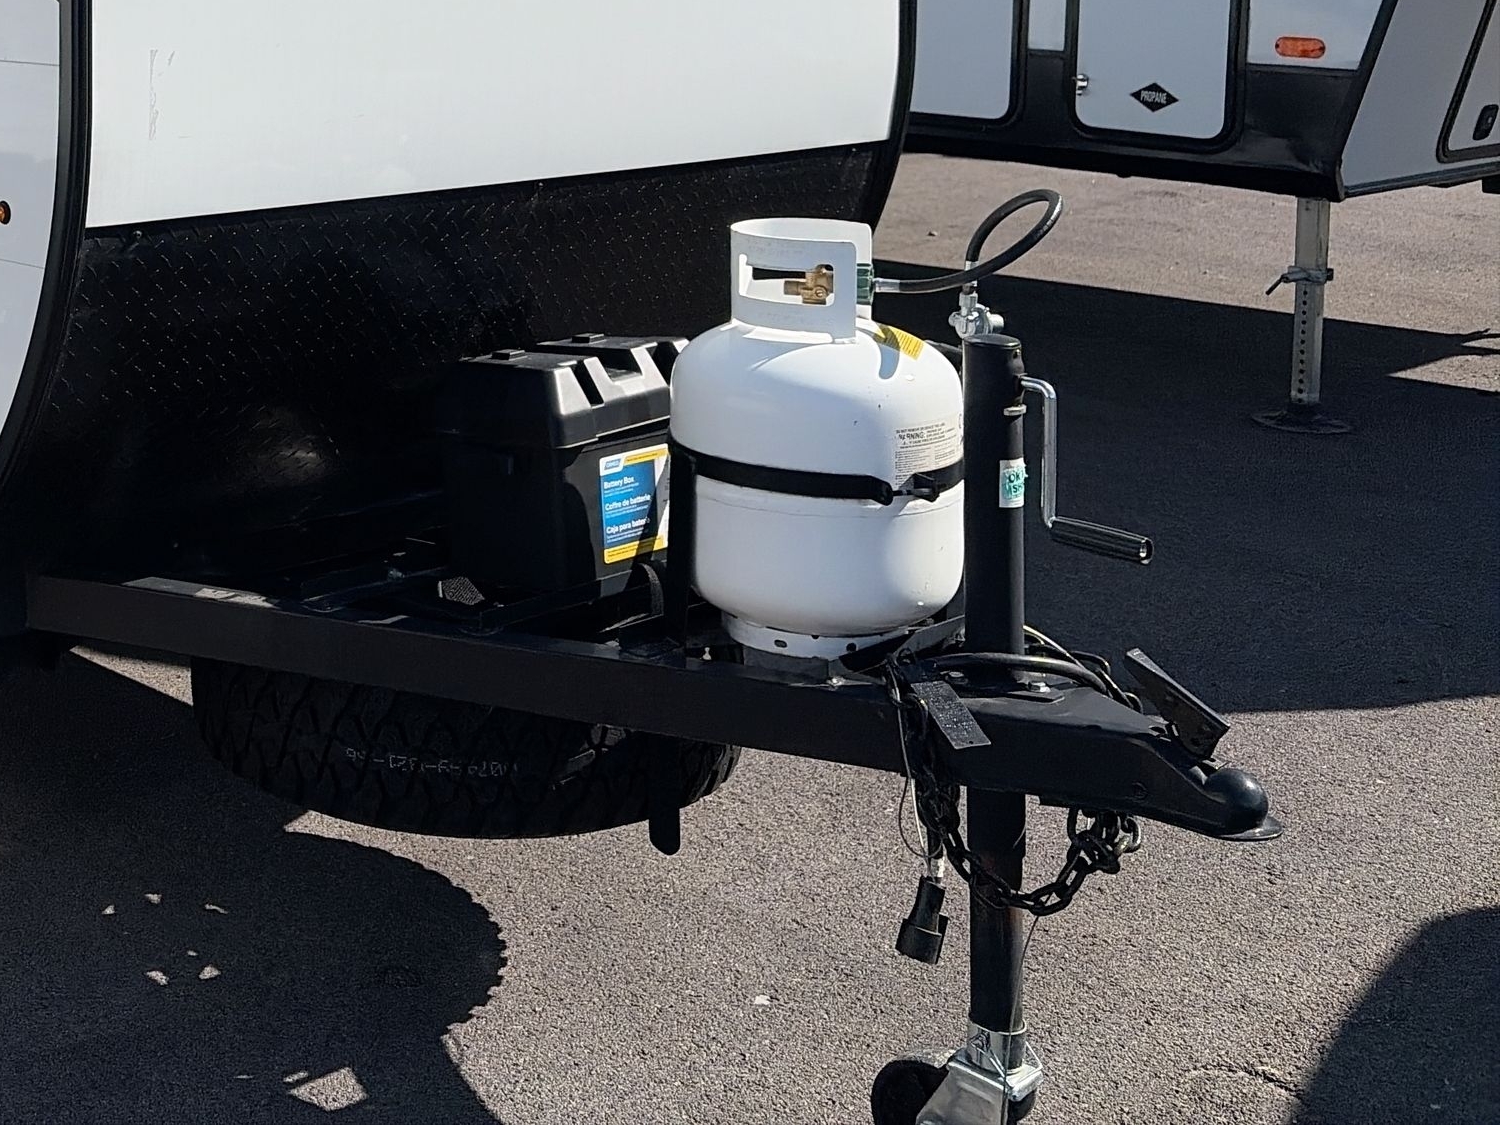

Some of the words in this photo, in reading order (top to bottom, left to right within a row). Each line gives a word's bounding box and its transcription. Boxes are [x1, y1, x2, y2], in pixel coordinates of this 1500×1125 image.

[1140, 90, 1168, 105] PROPANE
[603, 479, 623, 490] Battery
[623, 476, 635, 484] Box
[605, 501, 622, 511] Coffre
[622, 499, 629, 507] de
[629, 494, 651, 505] batterie
